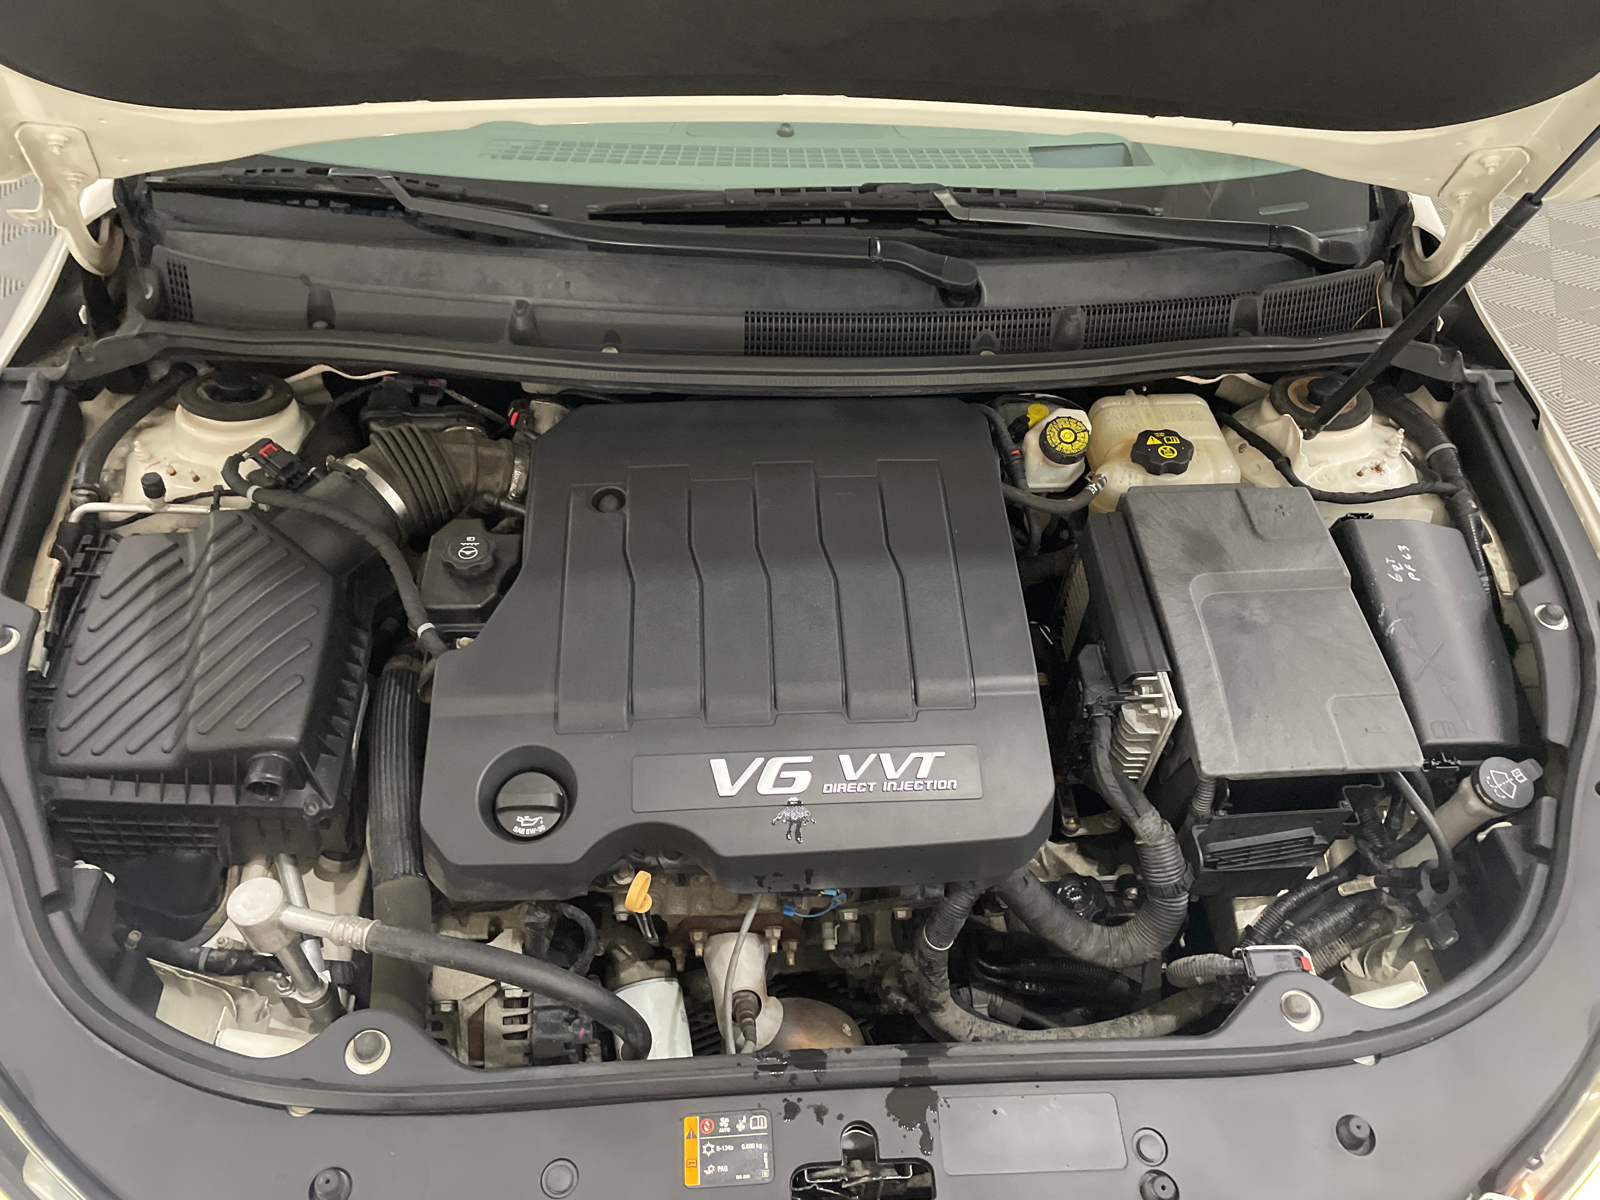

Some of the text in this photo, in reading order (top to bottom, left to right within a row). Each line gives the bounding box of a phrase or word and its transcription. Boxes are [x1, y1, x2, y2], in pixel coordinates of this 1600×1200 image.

[709, 751, 946, 797] V6 VVT
[822, 779, 958, 794] DIRECT INJECTION
[512, 825, 525, 835] SAE
[717, 1164, 728, 1173] PAG
